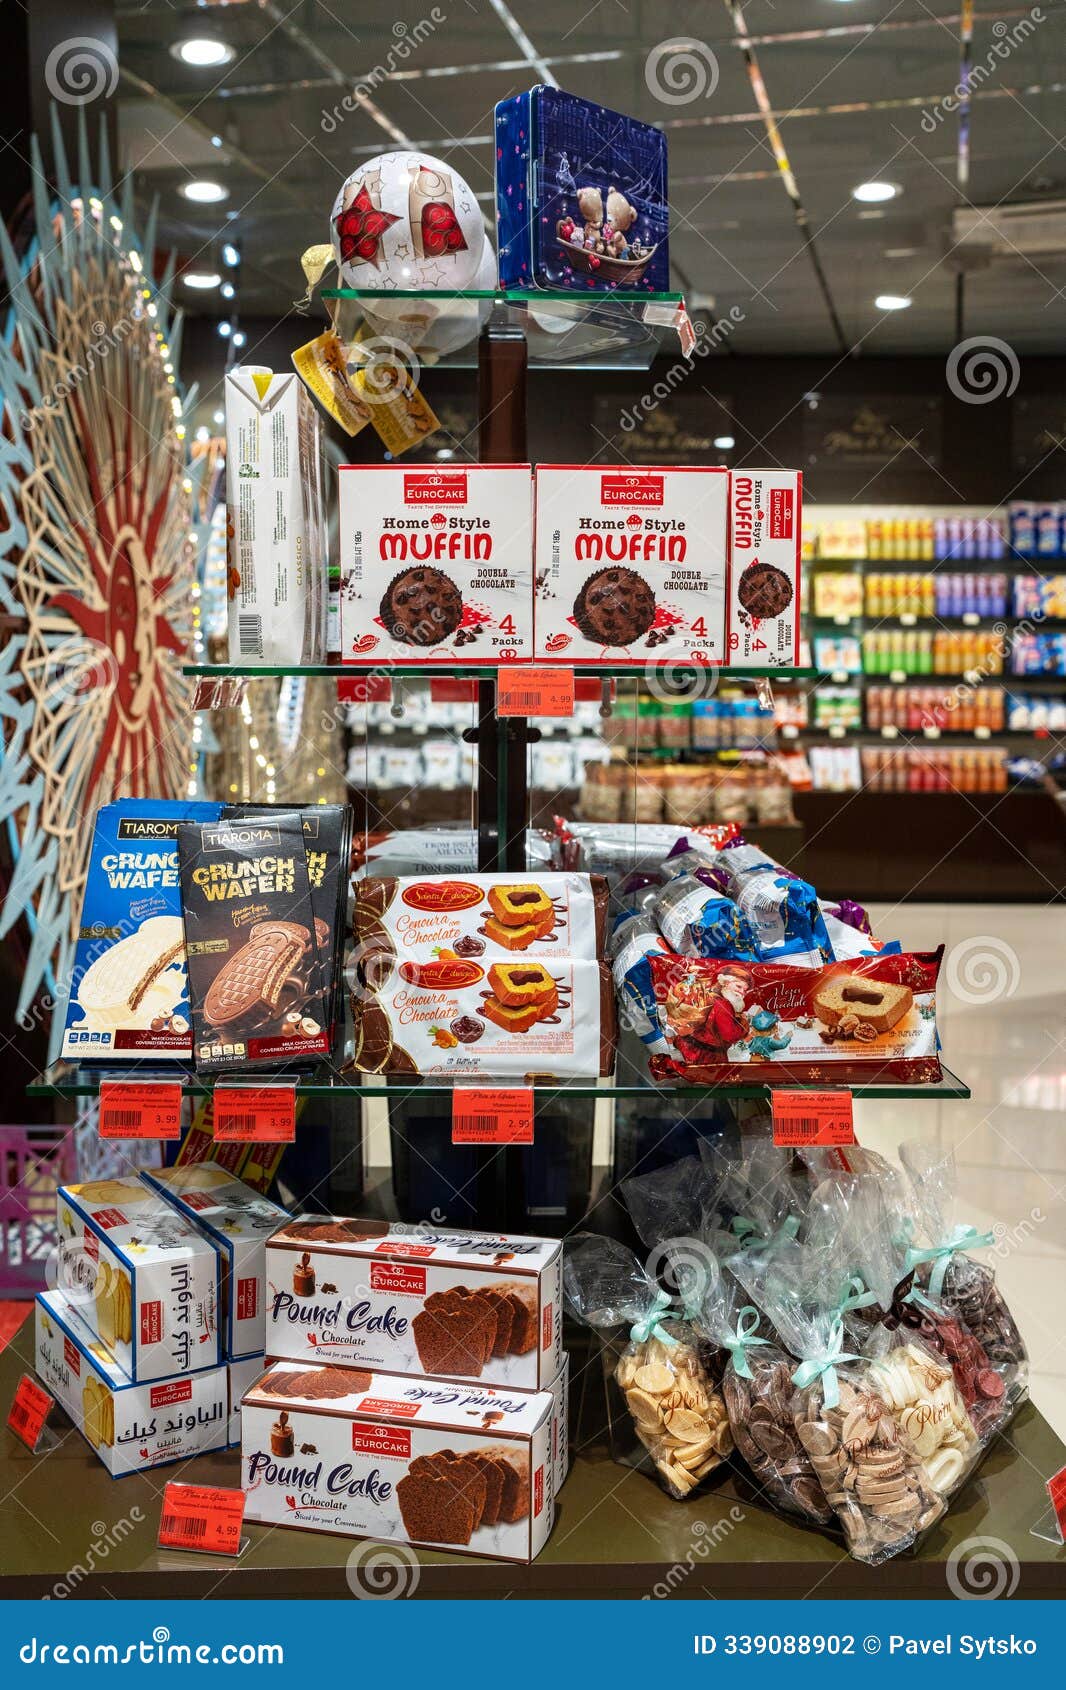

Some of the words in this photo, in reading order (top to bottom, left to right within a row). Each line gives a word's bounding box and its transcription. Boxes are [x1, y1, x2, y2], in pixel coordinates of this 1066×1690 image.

[754, 480, 762, 509] Home
[382, 517, 429, 530] Home
[448, 517, 491, 532] Style
[578, 518, 625, 530] Home
[644, 518, 686, 533] Style
[752, 521, 762, 548] Style
[477, 568, 508, 579] DOUBLE
[671, 570, 702, 580] DOUBLE
[470, 579, 516, 589] CHOCOLATE
[663, 581, 709, 591] CHOCOLATE
[498, 614, 517, 636] 4
[690, 616, 708, 638] 4
[491, 637, 524, 647] Packs
[683, 639, 715, 648] Packs
[777, 619, 785, 652] CHOCOLATE
[752, 638, 767, 652] 4
[551, 695, 571, 703] 4.99
[124, 822, 179, 834] TIAROM
[207, 829, 273, 845] TIAROMA
[101, 852, 180, 871] CRUNC
[192, 856, 295, 885] CRUNCH
[108, 870, 181, 889] WAFE
[201, 874, 295, 902] WAFER
[396, 914, 448, 932] Cenoura
[402, 928, 461, 947] Chocolate
[393, 991, 447, 1009] Cenoura
[399, 1006, 459, 1025] Chocolate
[155, 1114, 177, 1124] 3.99
[270, 1118, 292, 1127] 3.99
[508, 1119, 530, 1128] 2.99
[828, 1122, 850, 1131] 4.99
[272, 1290, 342, 1325] Pound
[346, 1301, 408, 1341] Cake
[321, 1330, 366, 1346] Chocolate
[332, 1351, 340, 1361] for
[340, 1353, 352, 1362] your
[353, 1351, 385, 1364] Convenience
[403, 1387, 459, 1405] Cake
[460, 1396, 528, 1414] Pound
[117, 1418, 157, 1443] كيك
[248, 1451, 323, 1492] Pound
[327, 1463, 392, 1505] Cake
[301, 1492, 348, 1511] Chocolate
[216, 1524, 238, 1536] 4.99
[312, 1513, 321, 1524] for
[321, 1517, 333, 1525] your
[334, 1516, 367, 1530] Convenience
